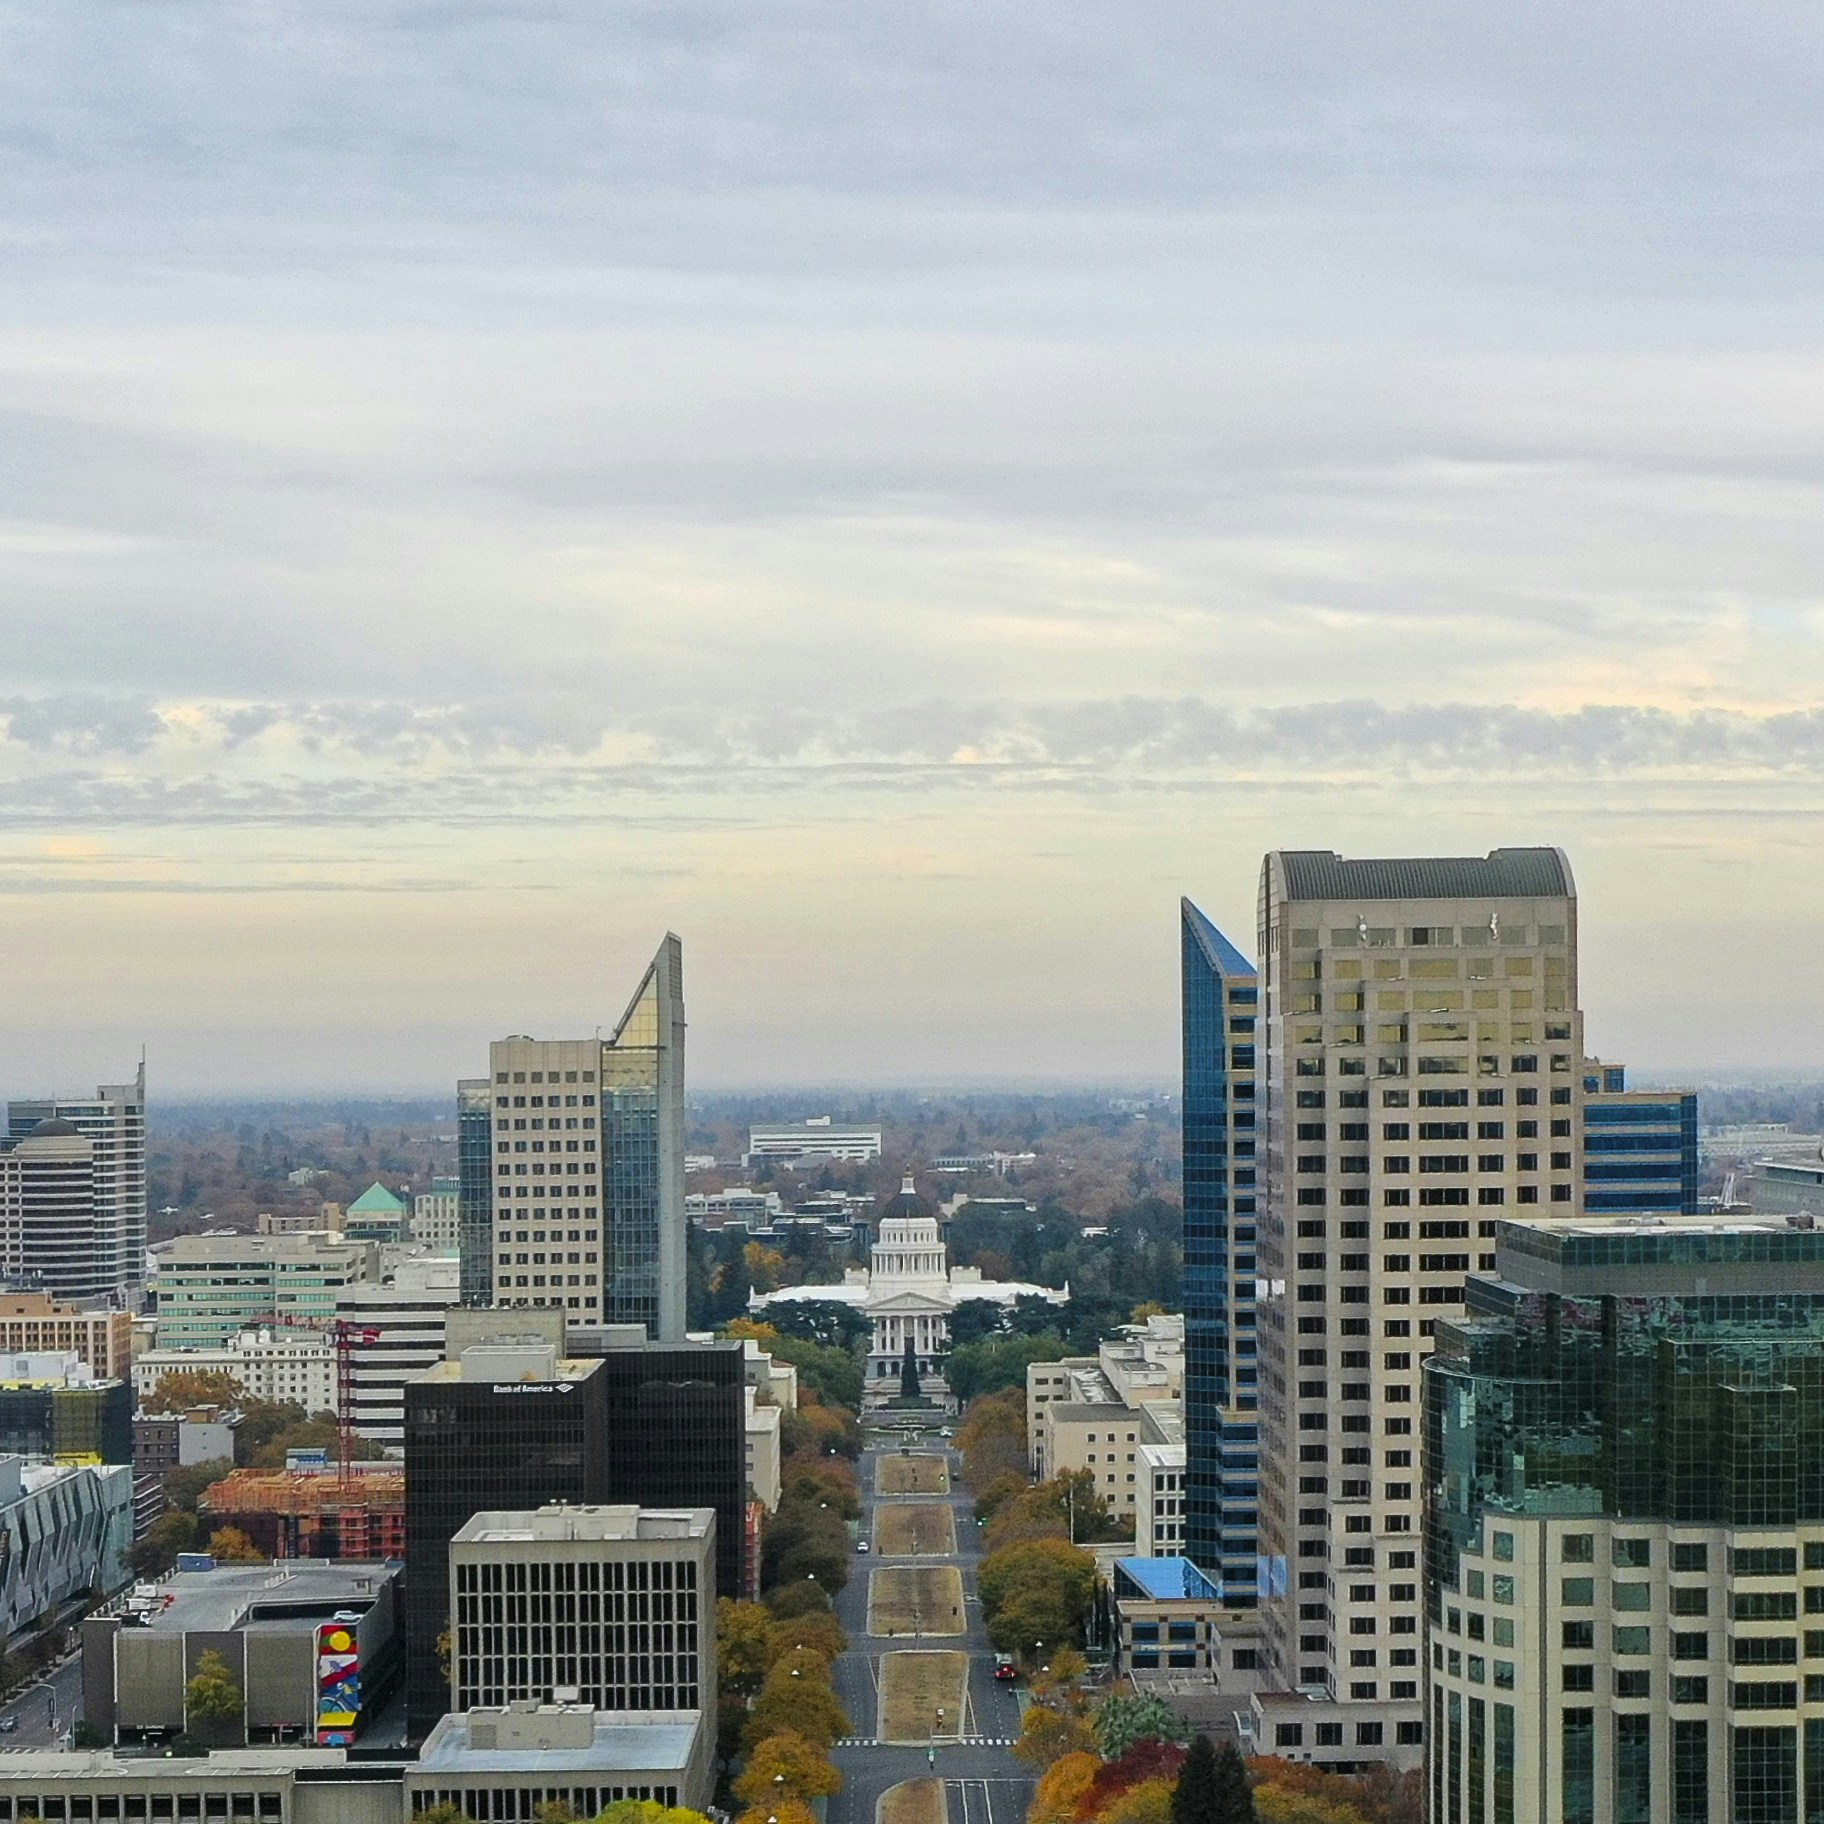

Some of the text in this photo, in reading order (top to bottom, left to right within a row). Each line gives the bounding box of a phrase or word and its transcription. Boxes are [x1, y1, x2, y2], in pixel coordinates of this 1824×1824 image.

[493, 1384, 553, 1393] Bank of America
